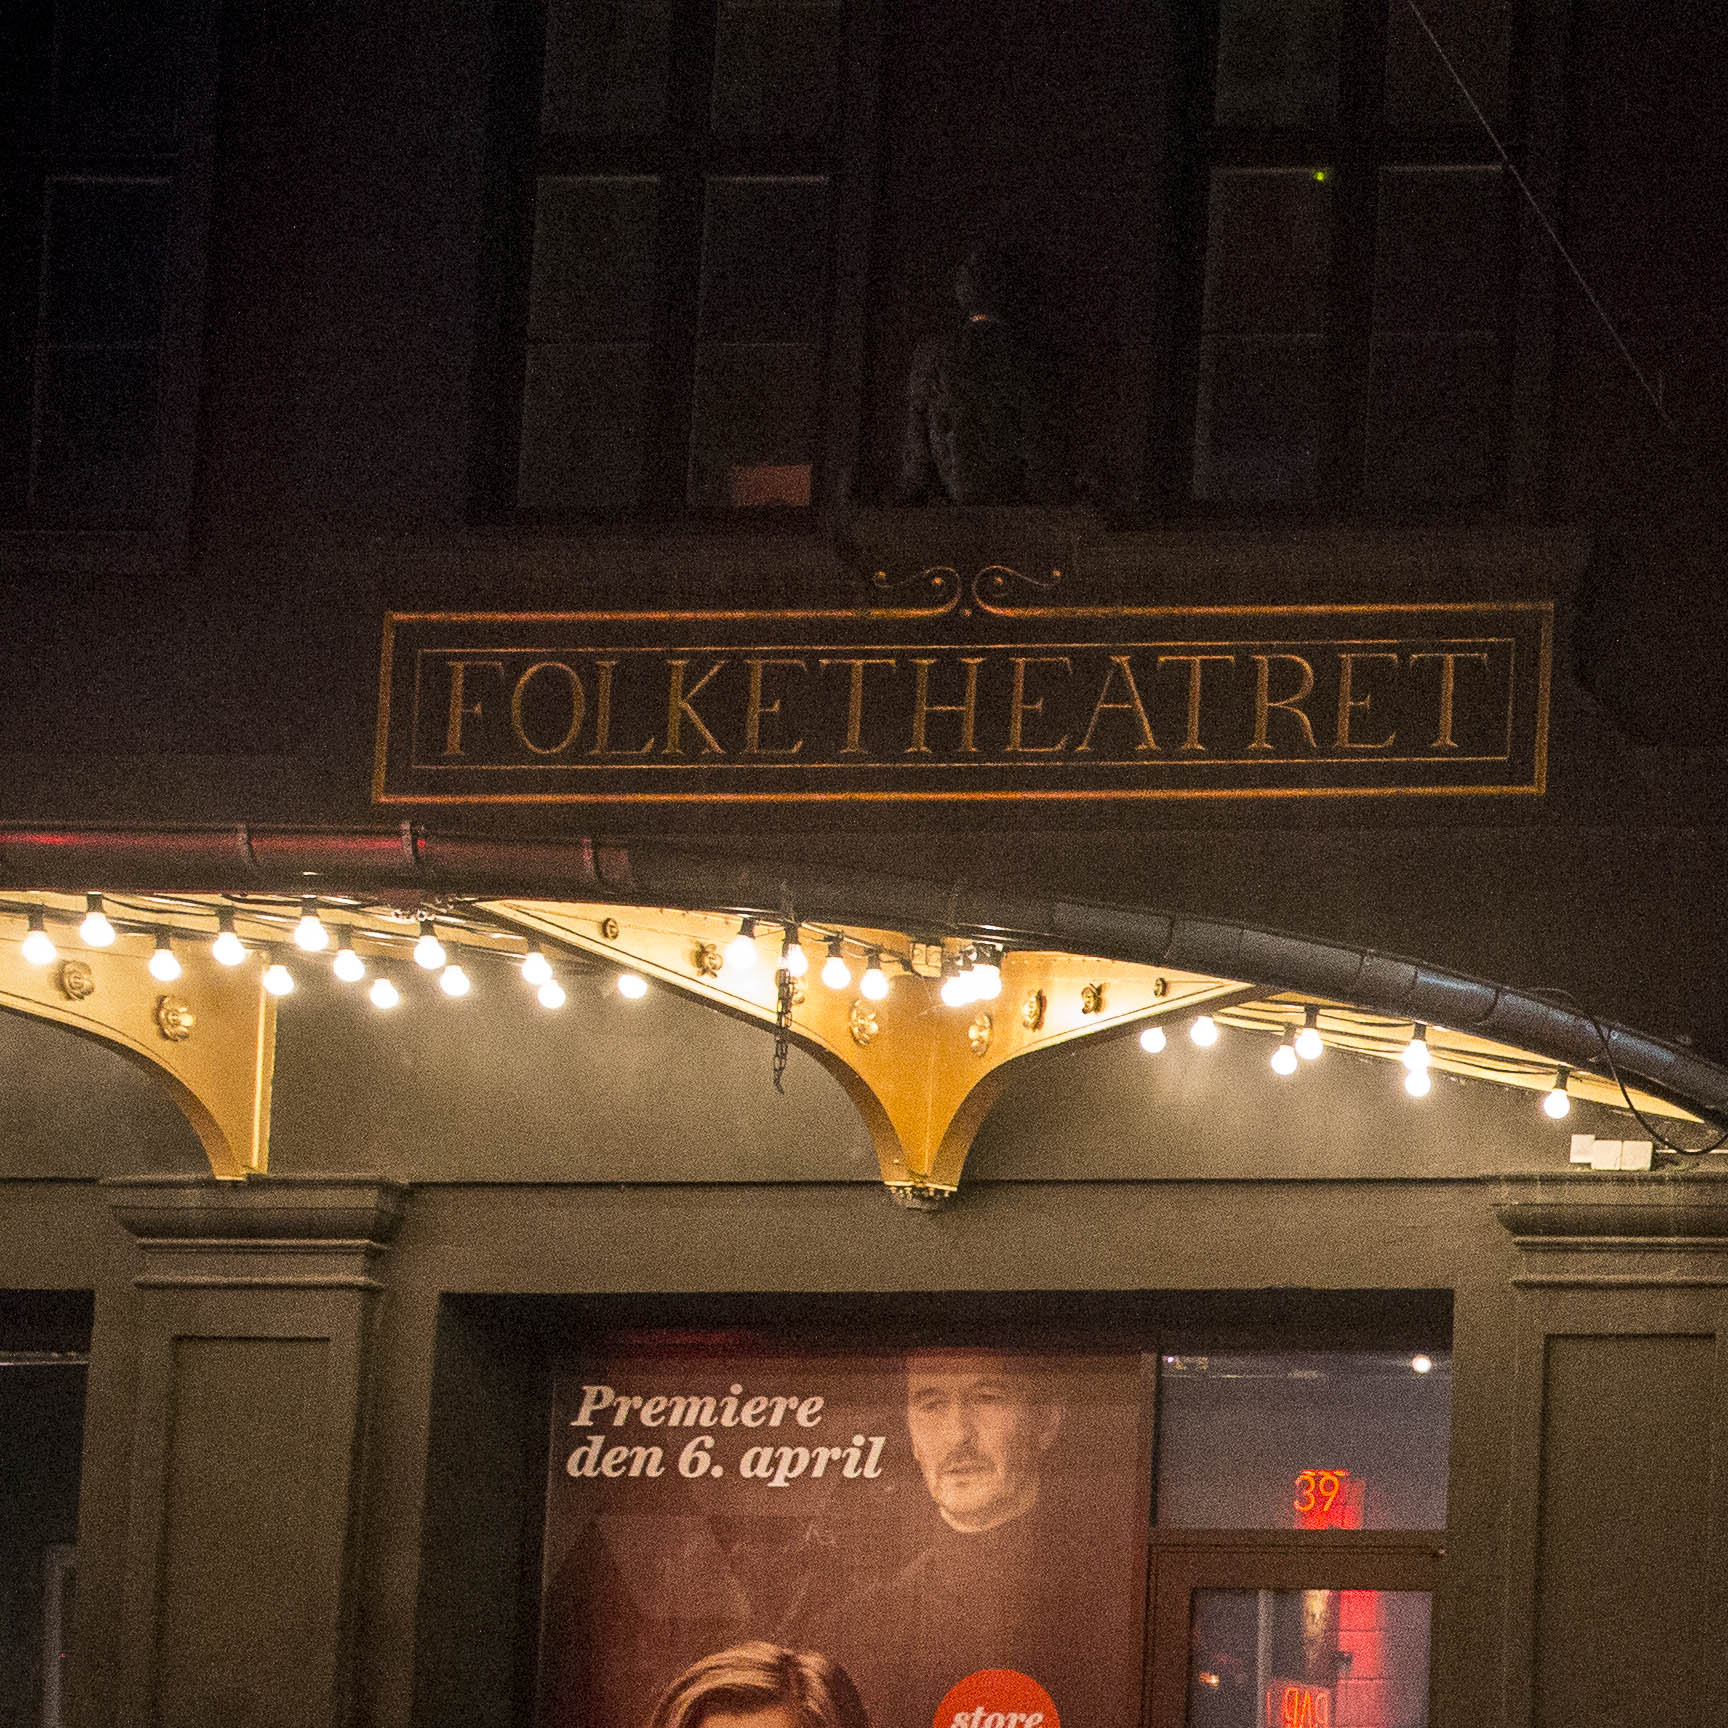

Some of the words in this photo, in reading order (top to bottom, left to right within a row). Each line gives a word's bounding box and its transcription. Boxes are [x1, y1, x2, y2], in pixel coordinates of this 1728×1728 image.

[442, 651, 1490, 756] FOLKETHEATRET
[570, 1384, 824, 1428] Premiere
[566, 1435, 665, 1478] den
[678, 1435, 724, 1479] 6.
[739, 1434, 887, 1488] april
[1293, 1474, 1338, 1512] 39
